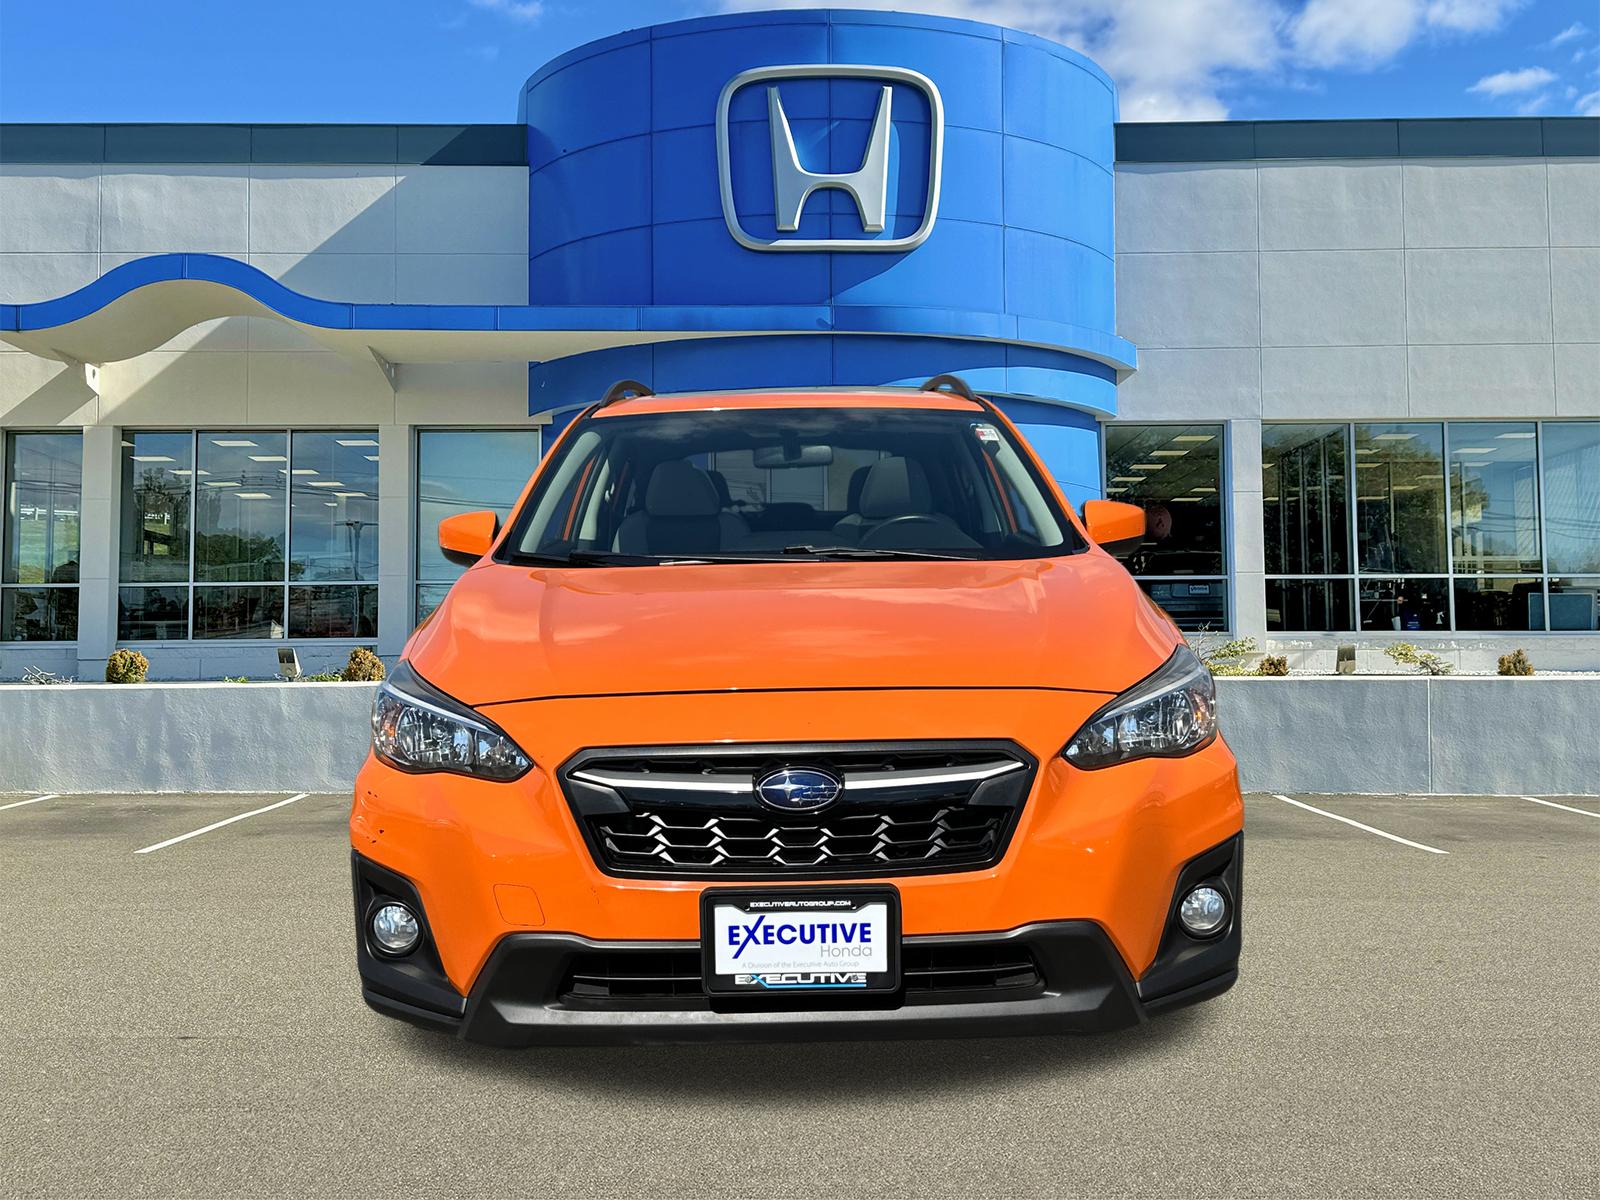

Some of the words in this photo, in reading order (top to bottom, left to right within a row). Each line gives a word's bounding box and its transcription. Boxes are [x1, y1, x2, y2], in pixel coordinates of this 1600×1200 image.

[749, 900, 852, 908] EXECUTIVEAUTOGROUP.COM
[728, 915, 872, 959] EXECUTIVE
[820, 945, 873, 958] Honda
[839, 960, 859, 968] Group
[735, 973, 867, 985] EXECUTIVE
